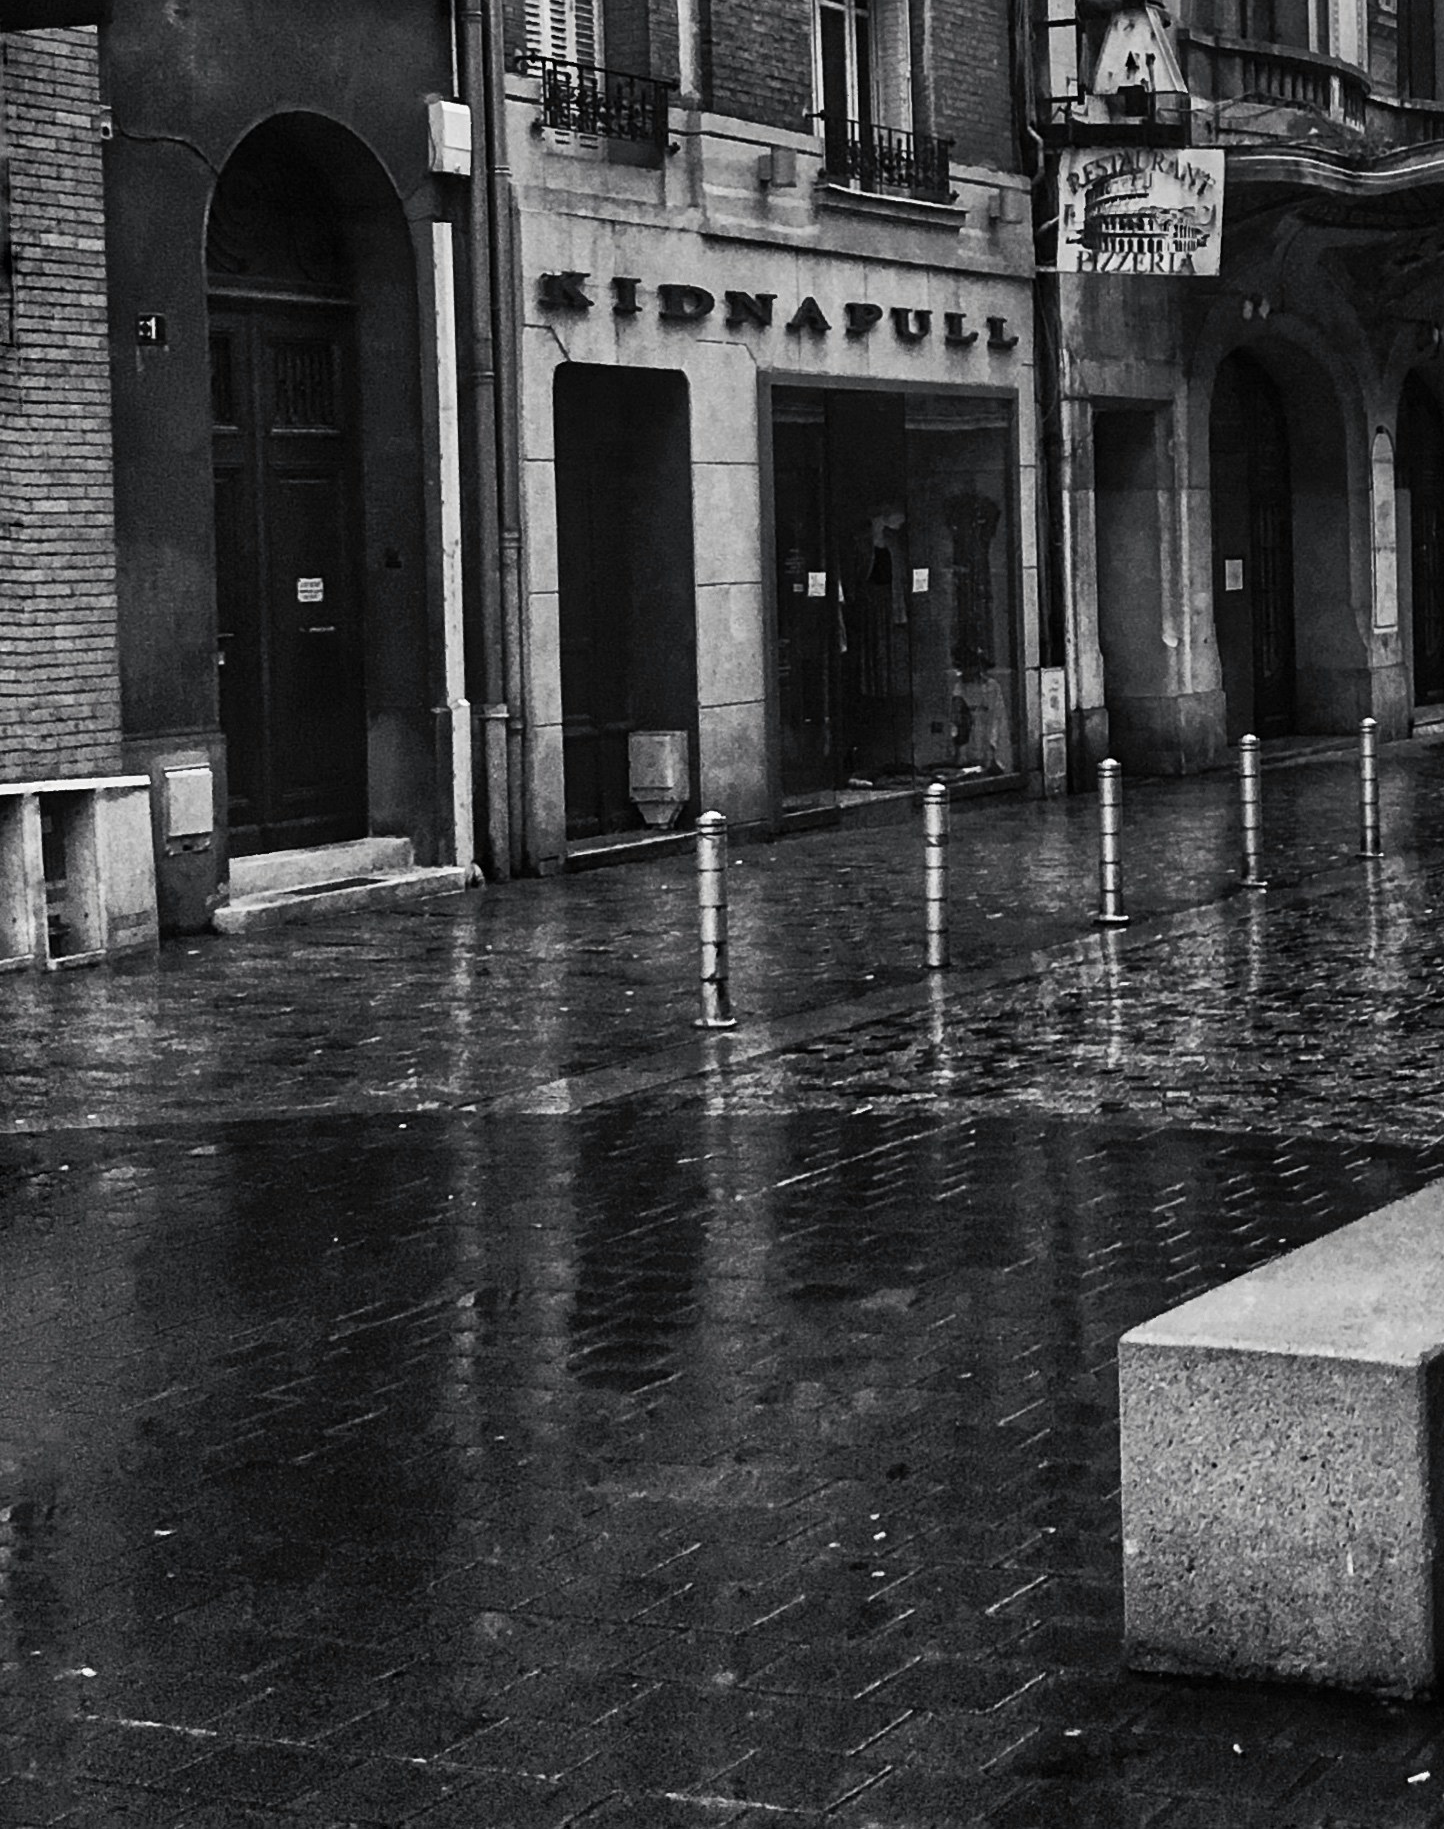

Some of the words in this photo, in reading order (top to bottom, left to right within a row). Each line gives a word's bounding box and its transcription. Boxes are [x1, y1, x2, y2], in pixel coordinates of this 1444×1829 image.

[1066, 151, 1217, 197] RESTAURANT
[1077, 250, 1197, 273] PIZZERIA
[538, 270, 1020, 350] KIDNAPULL
